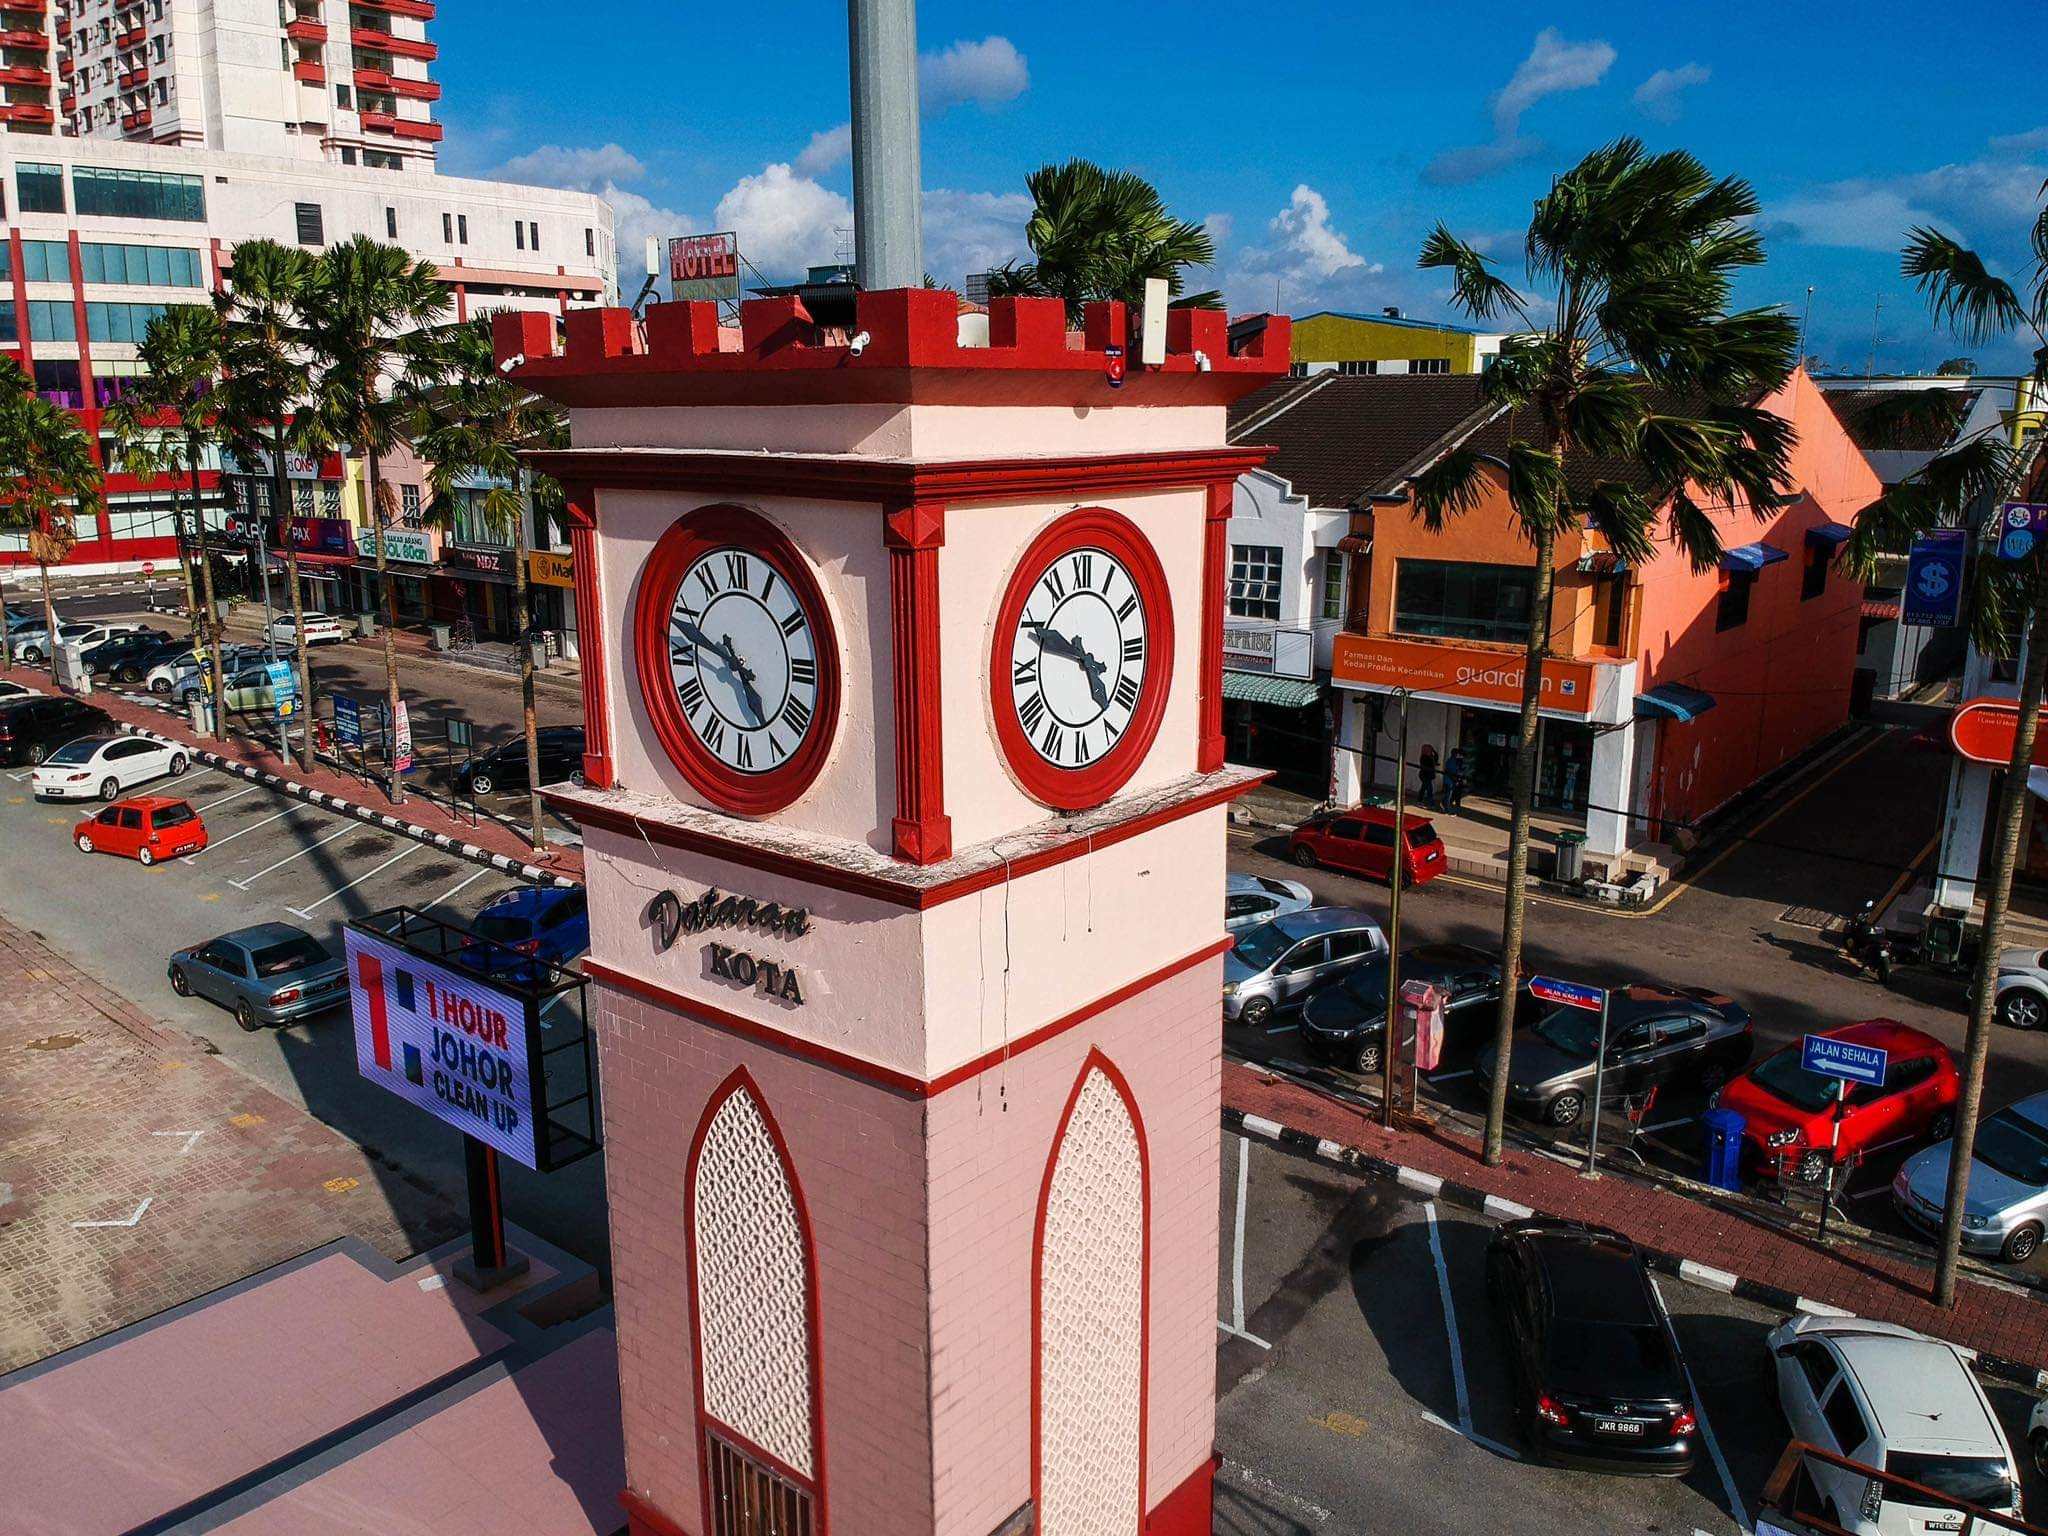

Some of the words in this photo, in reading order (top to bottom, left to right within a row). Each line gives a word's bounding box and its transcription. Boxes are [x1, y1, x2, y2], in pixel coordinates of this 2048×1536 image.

[1224, 629, 1272, 653] RPRISE
[1343, 650, 1375, 661] Farmasi
[1377, 654, 1393, 663] Dan
[1343, 659, 1366, 669] Kedai
[1367, 662, 1396, 672] Produk
[1397, 666, 1445, 679] Kecantikan
[1456, 666, 1552, 693] guardin
[710, 942, 805, 1006] KOTA
[1543, 988, 1561, 997] JALAN
[426, 980, 438, 1020] 1
[442, 989, 509, 1051] HOUR
[431, 1026, 515, 1101] JOHOR
[1809, 1040, 1840, 1057] JALAN
[1841, 1048, 1879, 1066] SEHALA
[433, 1070, 490, 1123] CLEAN
[493, 1101, 519, 1136] UP
[1599, 1421, 1616, 1432] JKR
